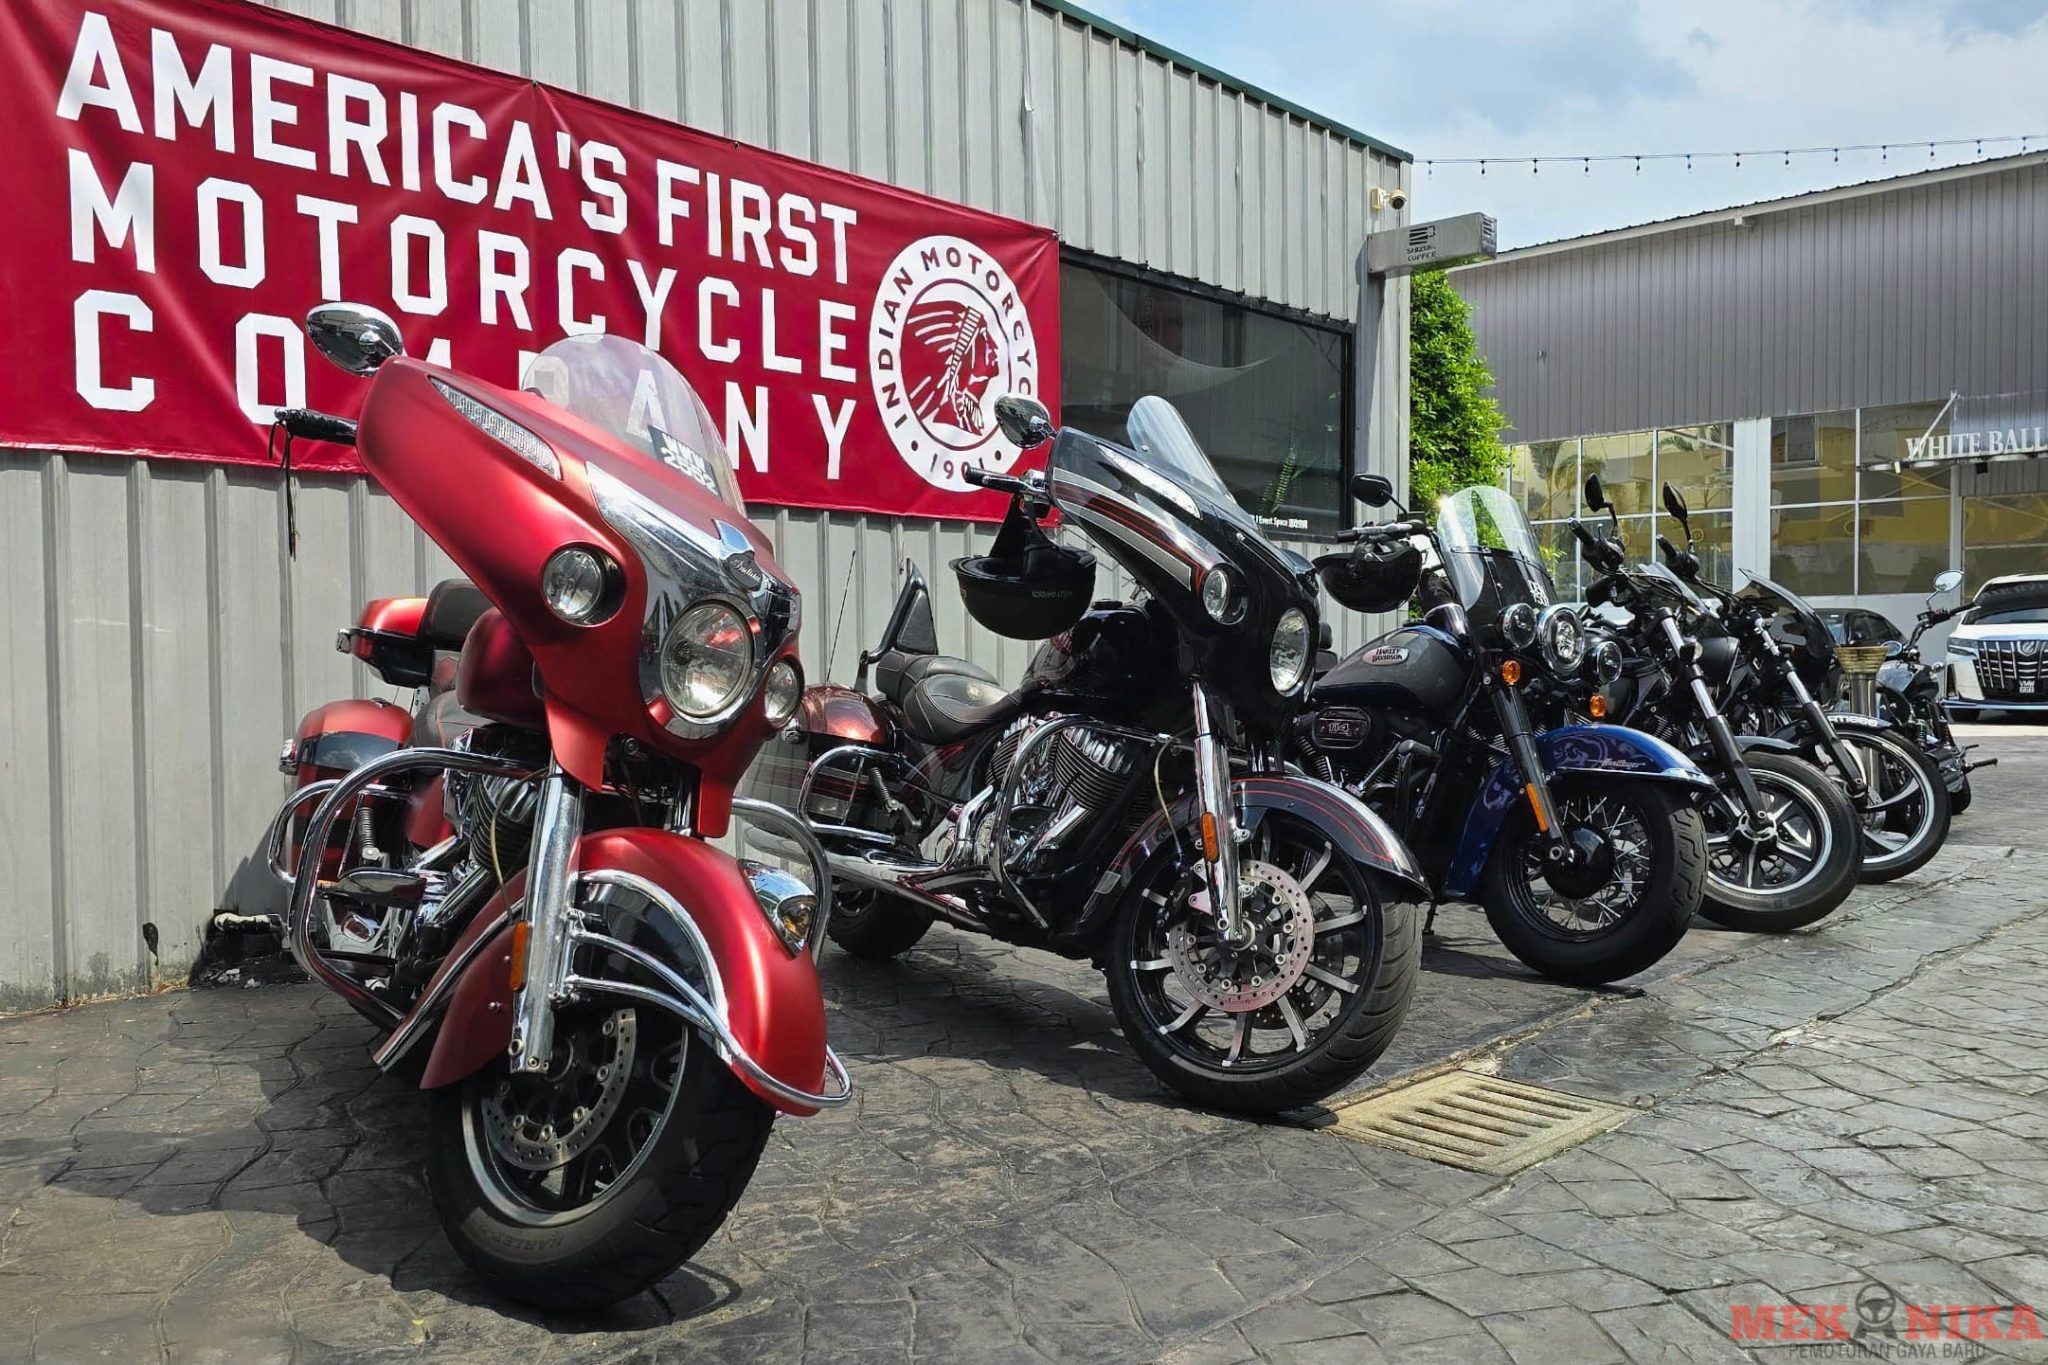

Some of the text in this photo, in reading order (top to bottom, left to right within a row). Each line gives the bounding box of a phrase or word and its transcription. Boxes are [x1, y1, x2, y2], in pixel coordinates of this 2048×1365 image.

[56, 11, 857, 284] AMERICA'S FIRST
[68, 148, 857, 382] MOTORCYCLE
[878, 267, 913, 429] INDIAN
[74, 290, 857, 480] COPANY
[1905, 427, 2047, 461] WHITE BALL
[1371, 654, 1403, 663] DAVIDSON
